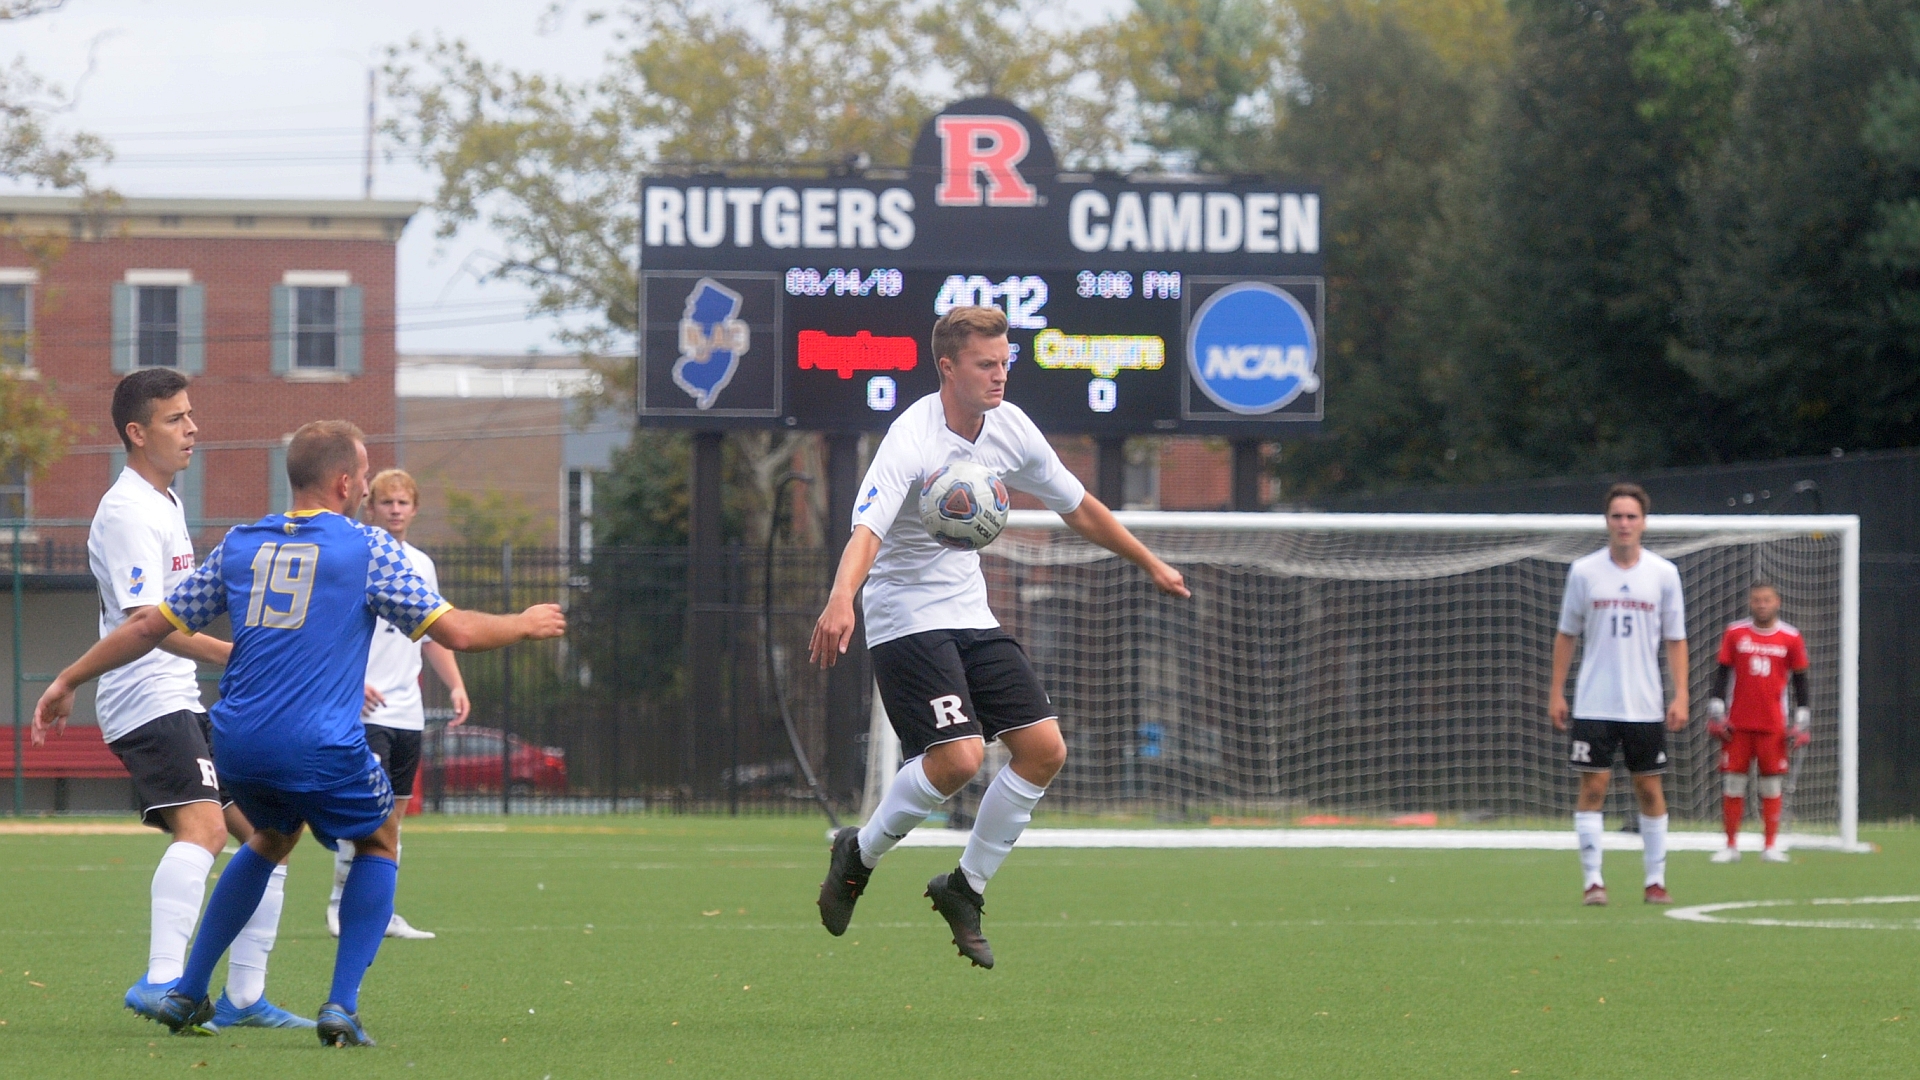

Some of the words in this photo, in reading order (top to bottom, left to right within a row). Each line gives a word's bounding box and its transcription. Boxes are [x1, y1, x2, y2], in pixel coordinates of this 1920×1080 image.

[935, 115, 1034, 206] R
[645, 186, 916, 249] RUTGERS
[1068, 190, 1321, 254] CAMDEN
[1142, 270, 1181, 299] PM
[1204, 345, 1308, 380] NCAA
[866, 376, 897, 412] 0
[1088, 378, 1117, 413] 0
[244, 542, 319, 629] 19
[1610, 615, 1633, 638] 15
[929, 694, 971, 729] R
[1570, 740, 1592, 763] R
[196, 757, 220, 791] R
